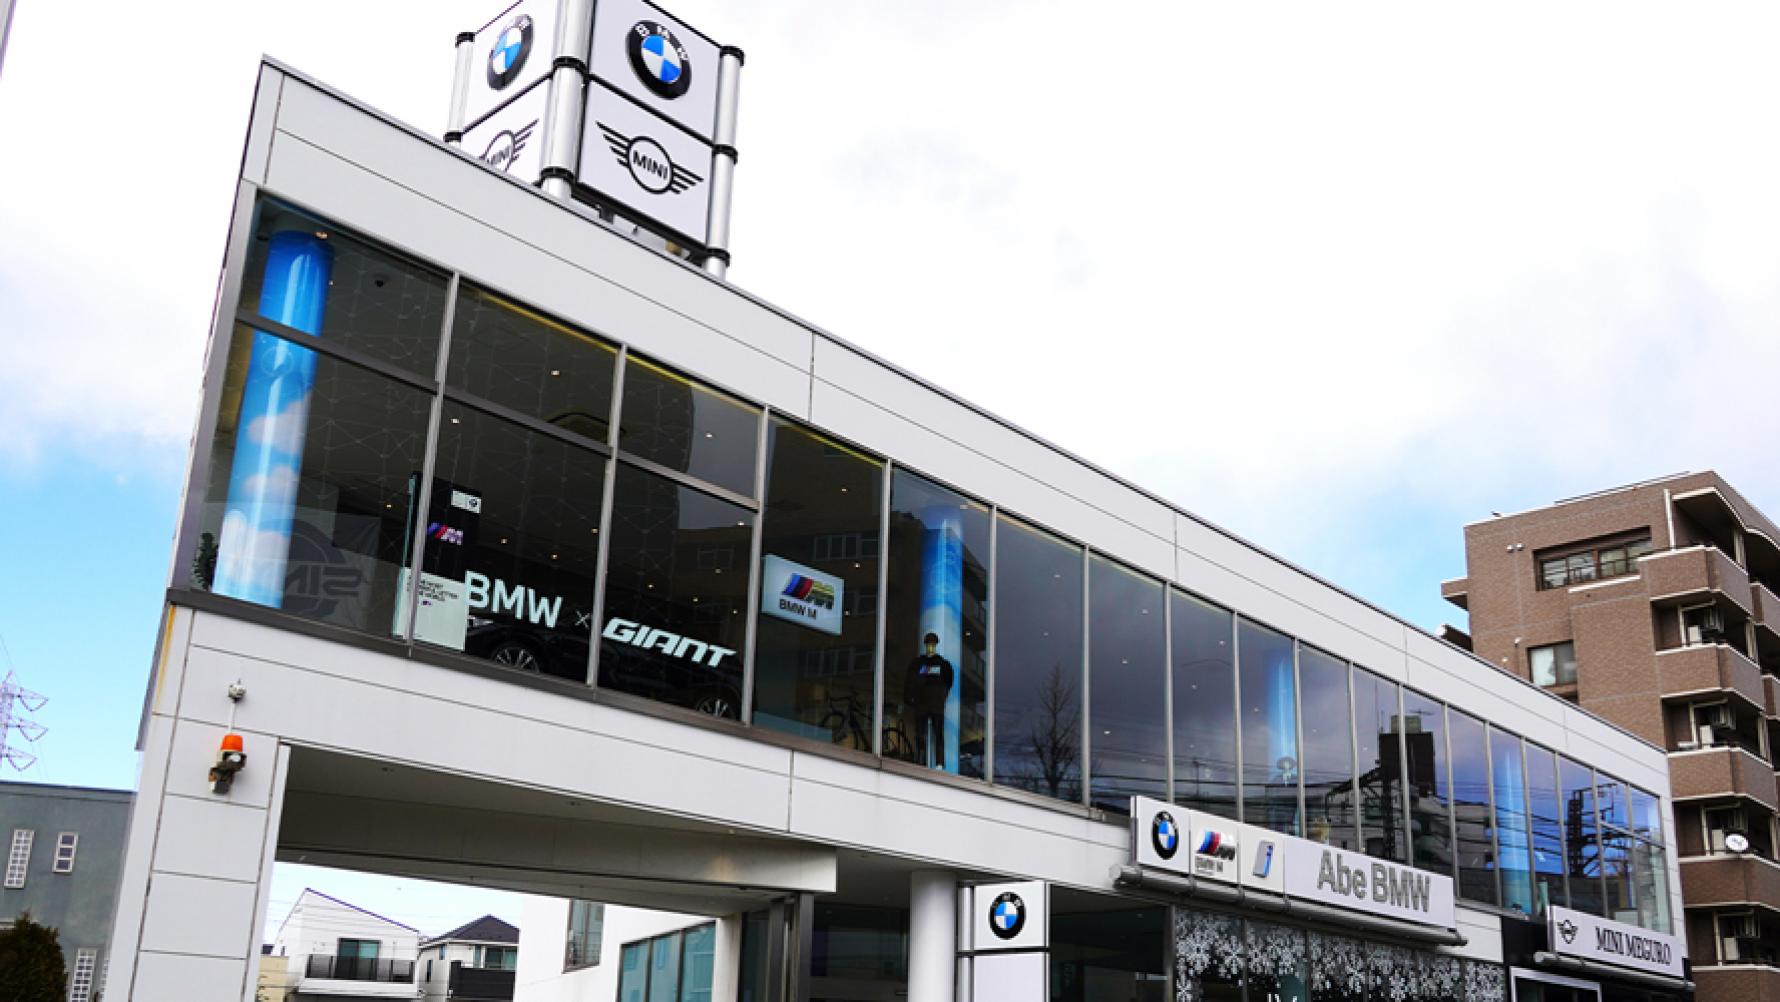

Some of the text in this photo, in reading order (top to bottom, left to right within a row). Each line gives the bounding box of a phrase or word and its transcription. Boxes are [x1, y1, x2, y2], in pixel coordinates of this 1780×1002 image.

[633, 149, 668, 181] MINI
[465, 570, 563, 629] BMW
[602, 616, 737, 668] GIANT
[1316, 848, 1430, 913] Abe BMW
[1595, 925, 1672, 966] MINI MEGURO
